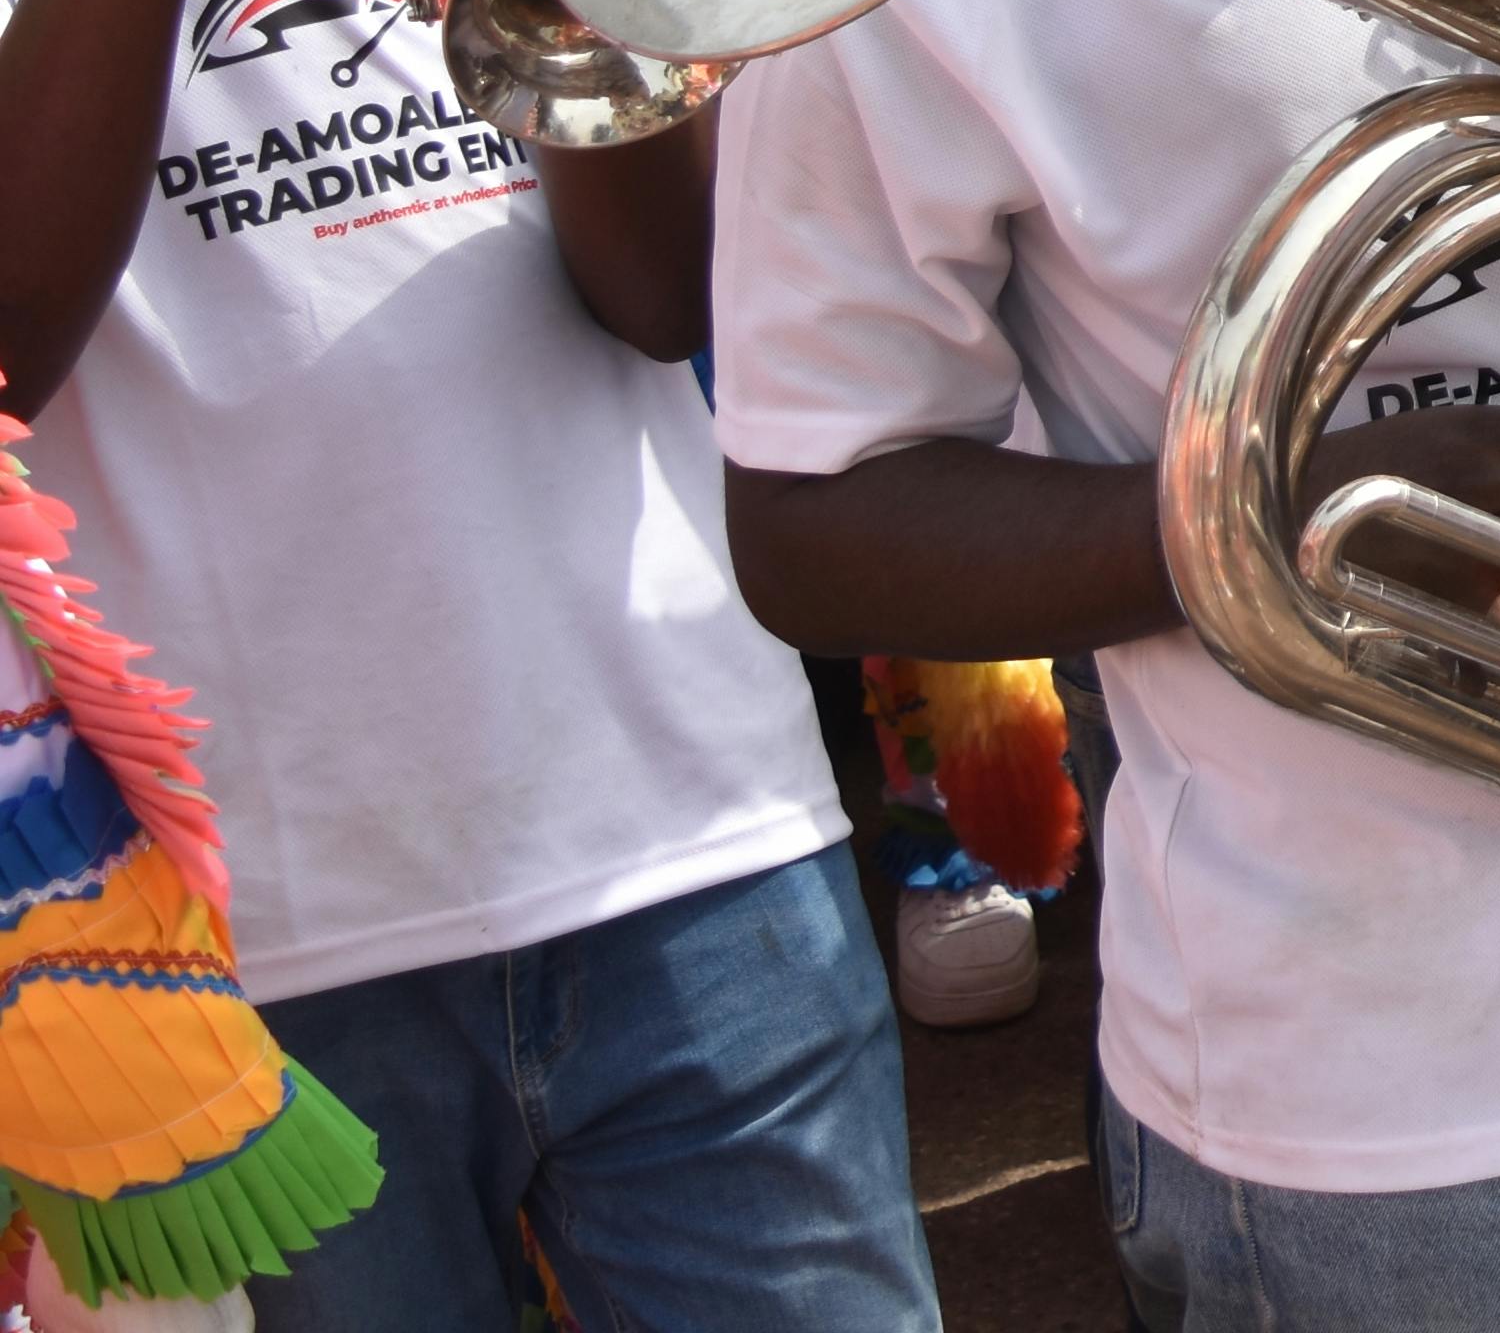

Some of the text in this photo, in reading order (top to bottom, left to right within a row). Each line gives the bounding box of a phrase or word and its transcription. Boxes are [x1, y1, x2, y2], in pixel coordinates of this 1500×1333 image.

[185, 129, 528, 241] TRADING ENT
[313, 219, 348, 240] Buy
[353, 200, 431, 231] authentic
[434, 194, 450, 210] at
[511, 177, 539, 194] Price
